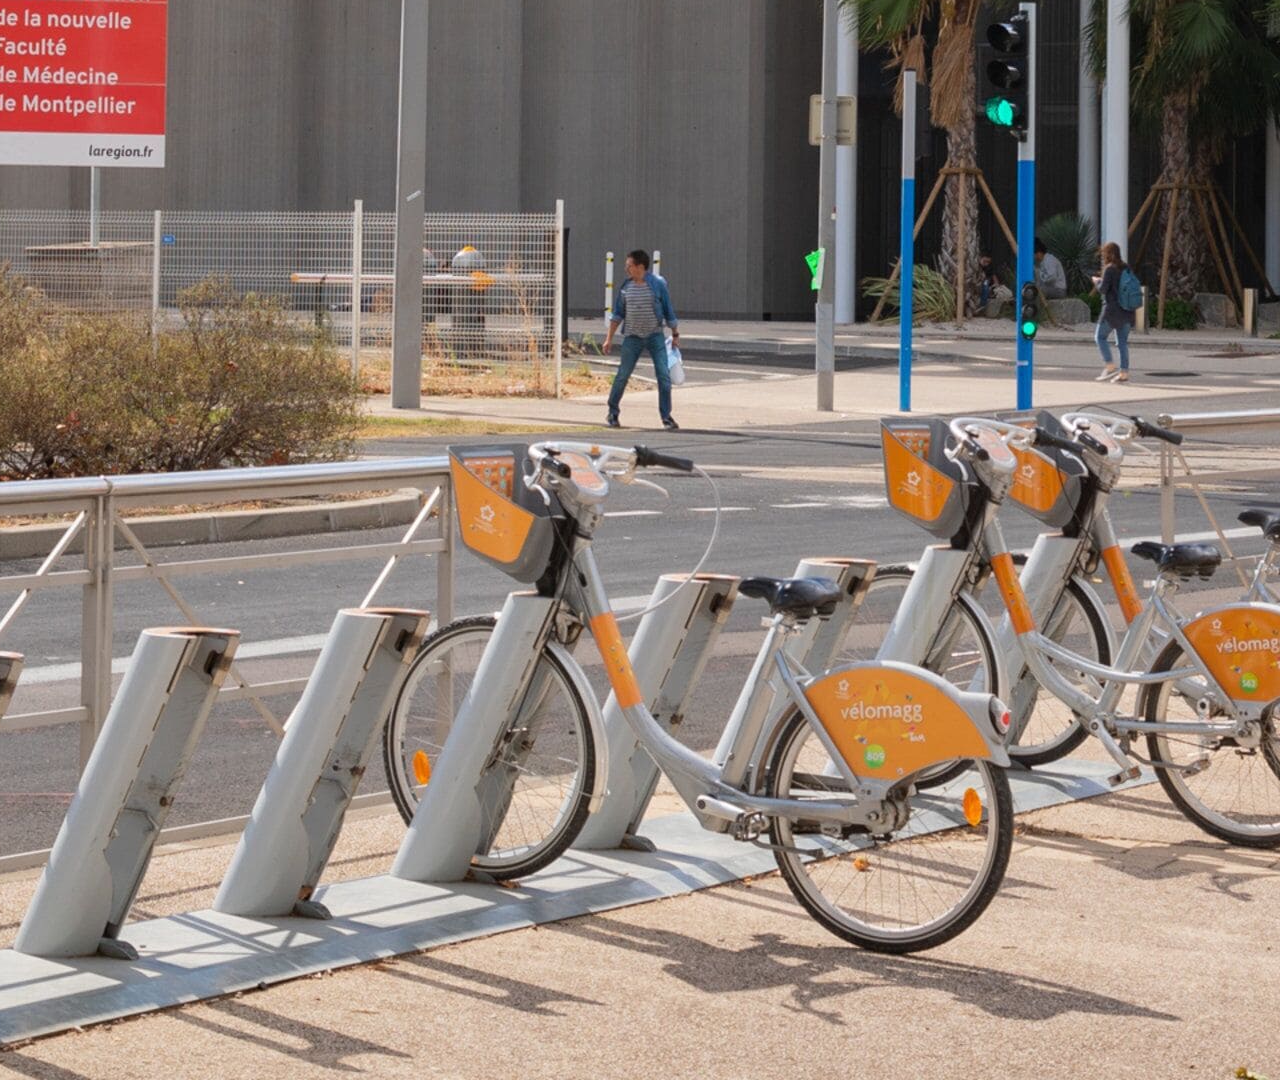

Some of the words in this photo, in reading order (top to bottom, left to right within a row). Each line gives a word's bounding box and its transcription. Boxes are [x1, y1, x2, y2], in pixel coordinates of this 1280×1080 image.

[24, 8, 41, 27] la
[47, 11, 132, 30] nouvelle
[23, 65, 119, 85] Médecine
[22, 94, 136, 117] Montpellier
[88, 144, 154, 159] laregion.fr
[840, 700, 923, 723] vélomagg
